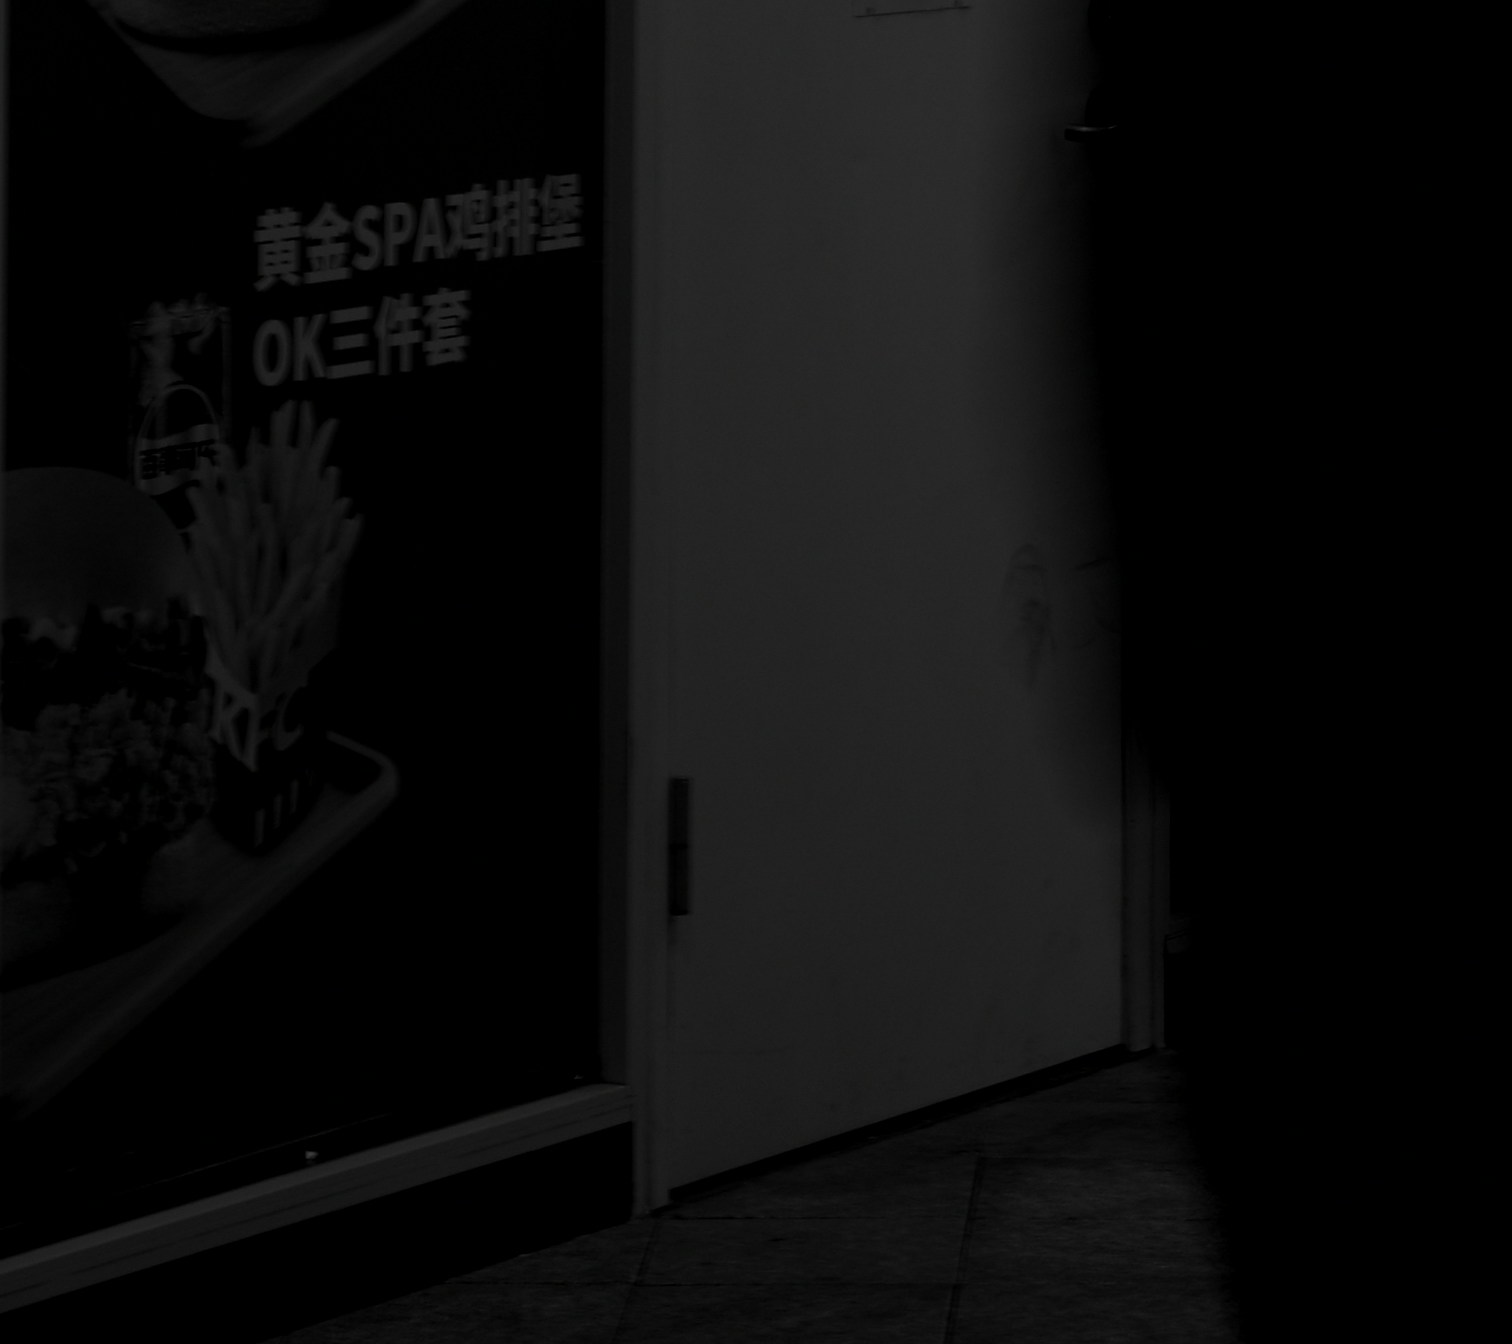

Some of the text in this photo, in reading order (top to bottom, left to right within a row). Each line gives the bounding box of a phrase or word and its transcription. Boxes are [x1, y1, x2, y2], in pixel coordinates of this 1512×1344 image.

[253, 173, 586, 294] 黄金SPA鸡排堡
[252, 287, 473, 388] OK三件套
